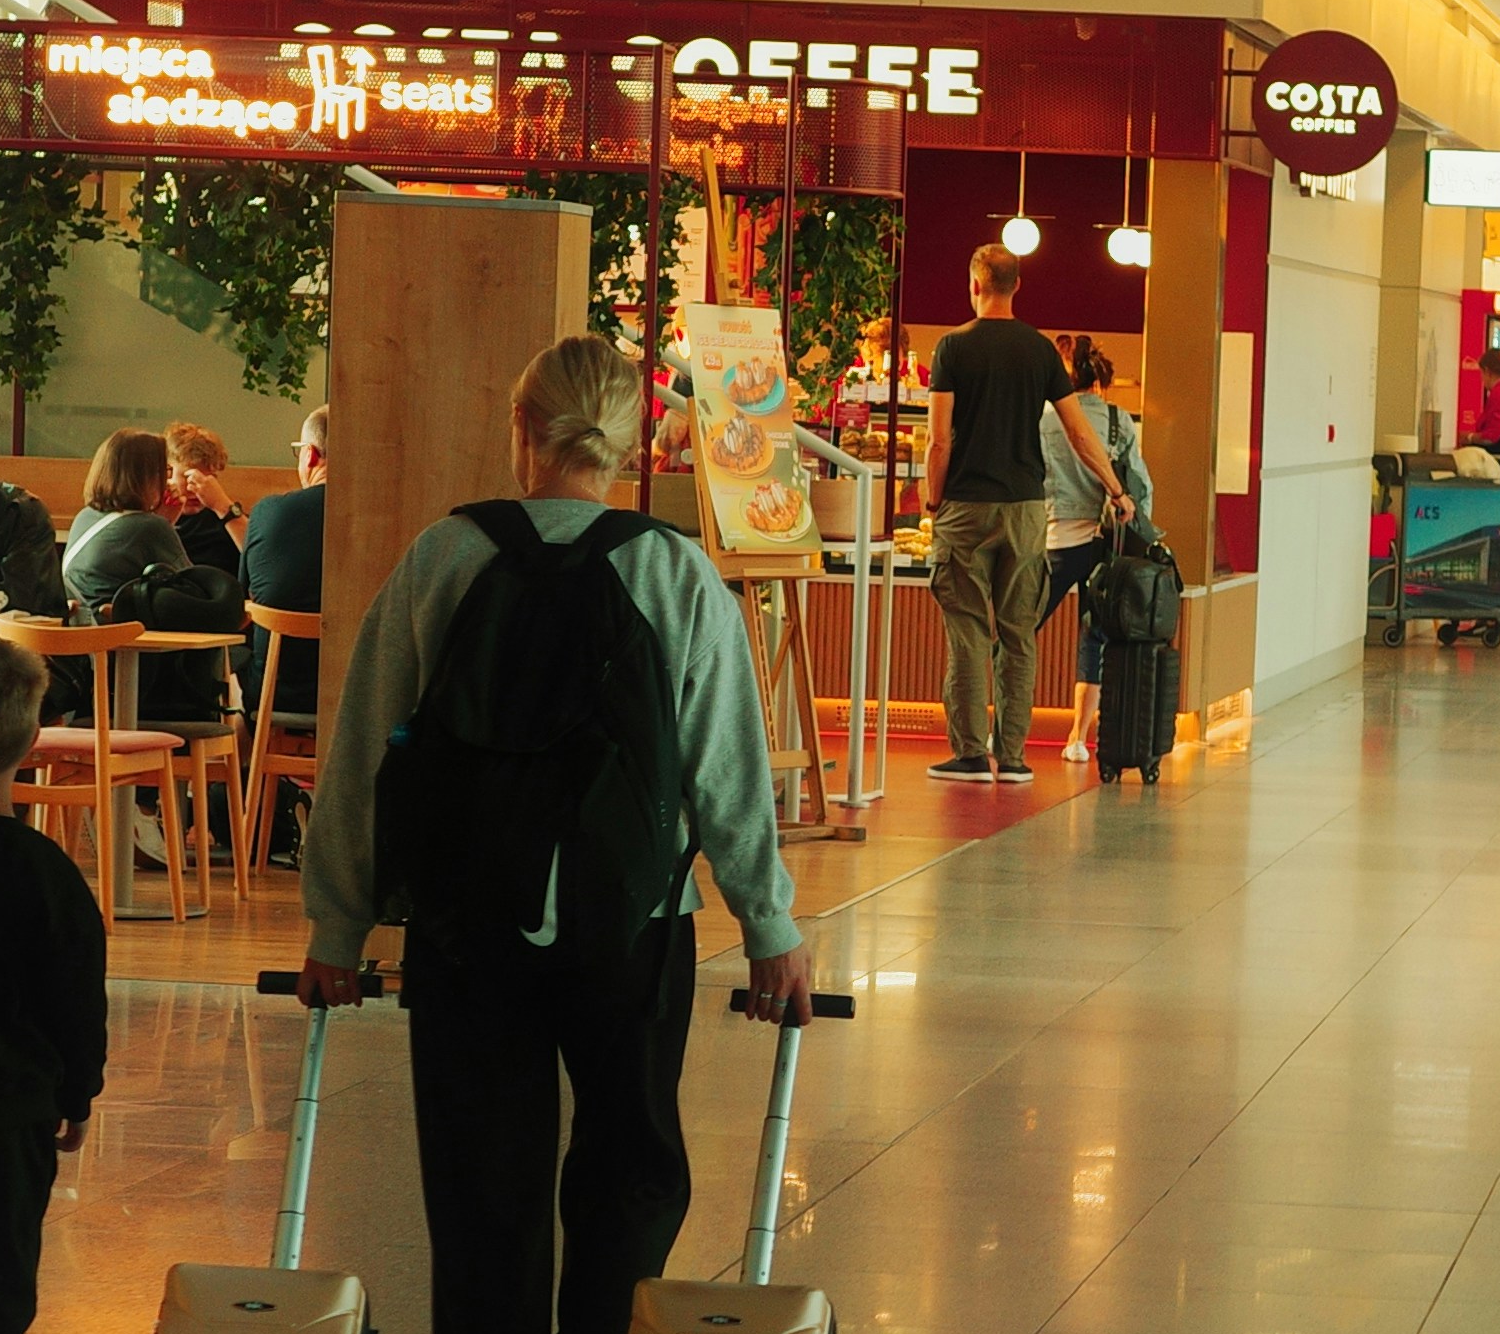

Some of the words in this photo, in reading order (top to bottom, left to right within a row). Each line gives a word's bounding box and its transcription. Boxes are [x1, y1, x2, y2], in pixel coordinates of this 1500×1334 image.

[48, 36, 213, 83] miejsca
[107, 87, 298, 137] siedzące
[380, 78, 493, 113] seats
[1265, 81, 1383, 117] COSTA
[1290, 116, 1357, 134] COFFEE
[1414, 506, 1440, 520] ACS
